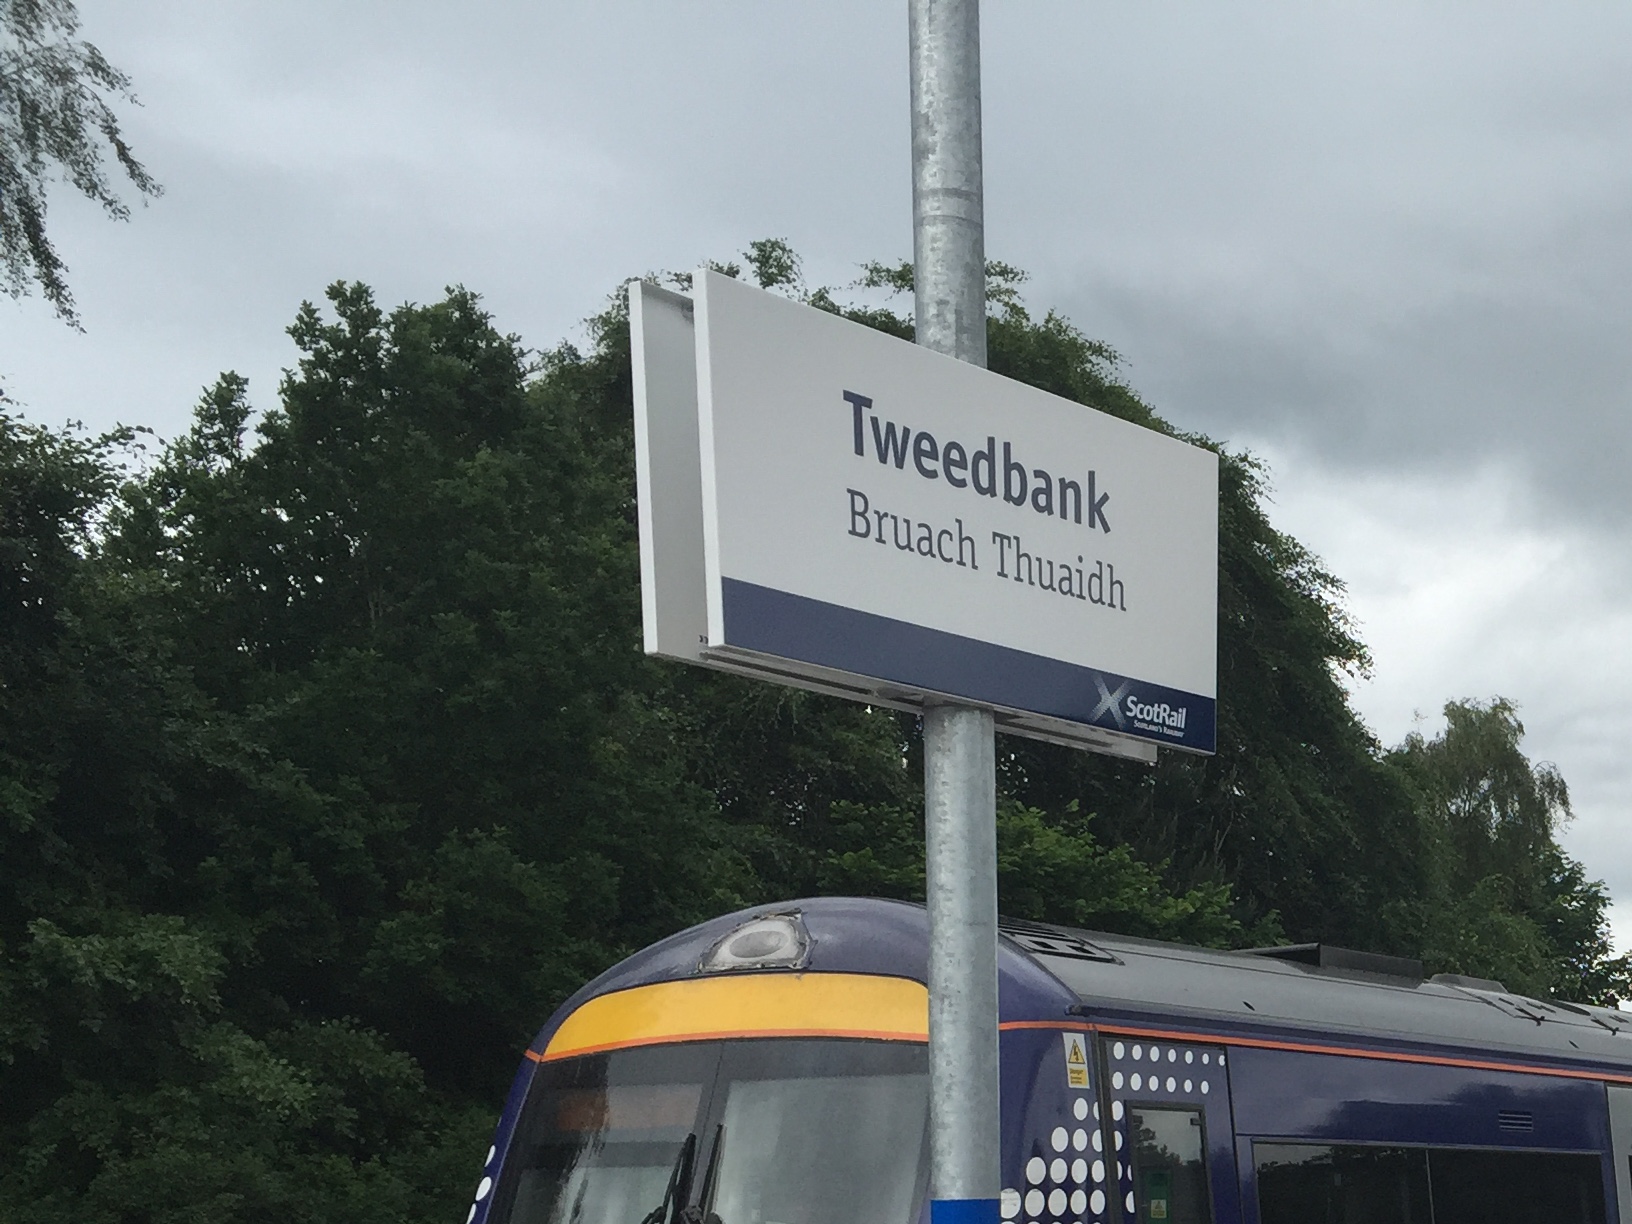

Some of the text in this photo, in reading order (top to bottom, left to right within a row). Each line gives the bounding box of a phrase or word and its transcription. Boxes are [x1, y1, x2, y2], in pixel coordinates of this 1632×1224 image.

[843, 389, 1111, 534] Tweedbank
[846, 487, 1127, 612] Bruach Thuaidh
[1126, 695, 1186, 729] ScotRail
